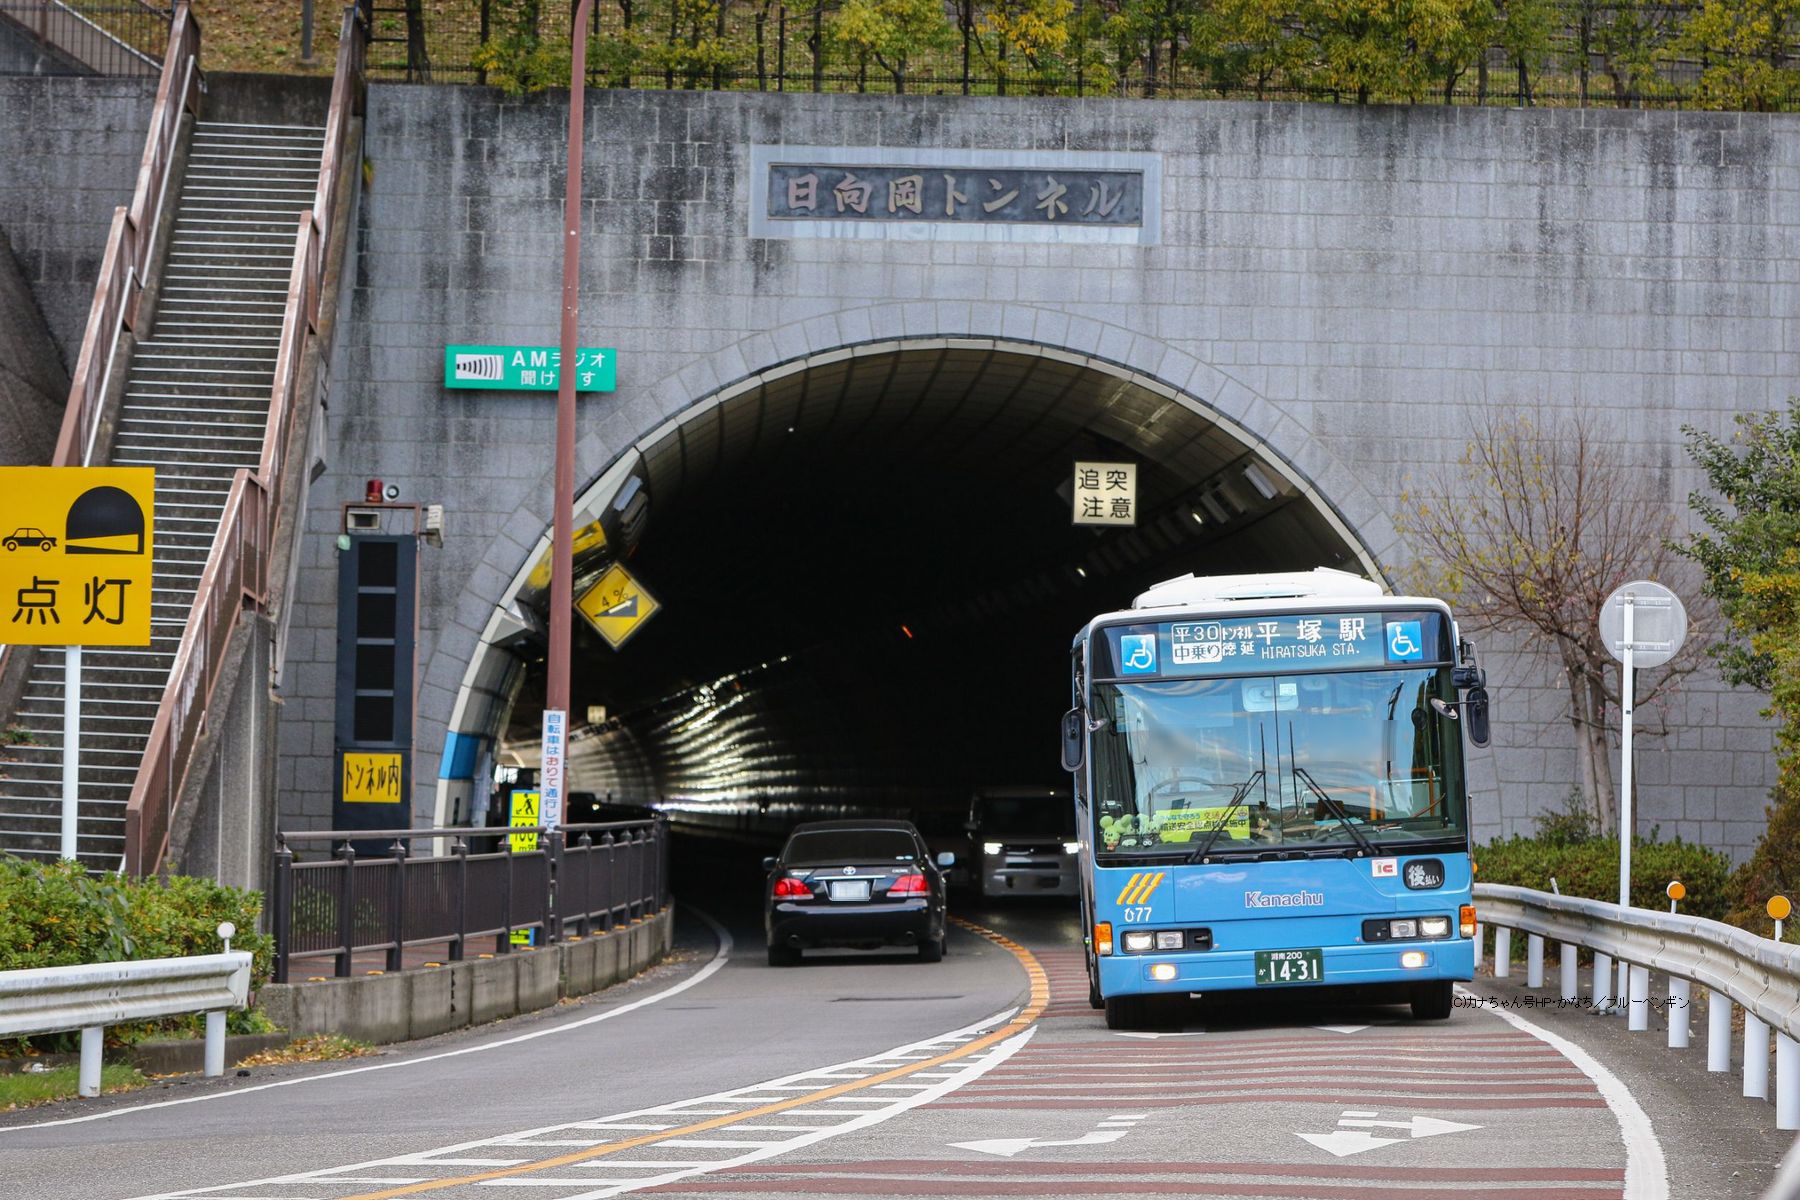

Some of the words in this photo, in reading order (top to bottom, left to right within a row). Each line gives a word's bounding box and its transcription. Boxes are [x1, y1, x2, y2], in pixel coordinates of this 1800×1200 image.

[786, 171, 1123, 221] 日向岡トンネル
[520, 370, 596, 387] 聞けす
[1078, 468, 1127, 491] 追突
[1082, 496, 1132, 518] 注意
[12, 575, 132, 625] 点灯
[1256, 617, 1366, 645] 平塚駅
[1175, 644, 1220, 661] 中乗り
[1261, 644, 1327, 660] HIRATSUKA
[1332, 643, 1360, 656] STA.
[345, 757, 399, 797] トンネル内
[1408, 865, 1440, 886] 後払い
[1245, 890, 1324, 908] Kanachu
[1270, 959, 1318, 981] 14-31
